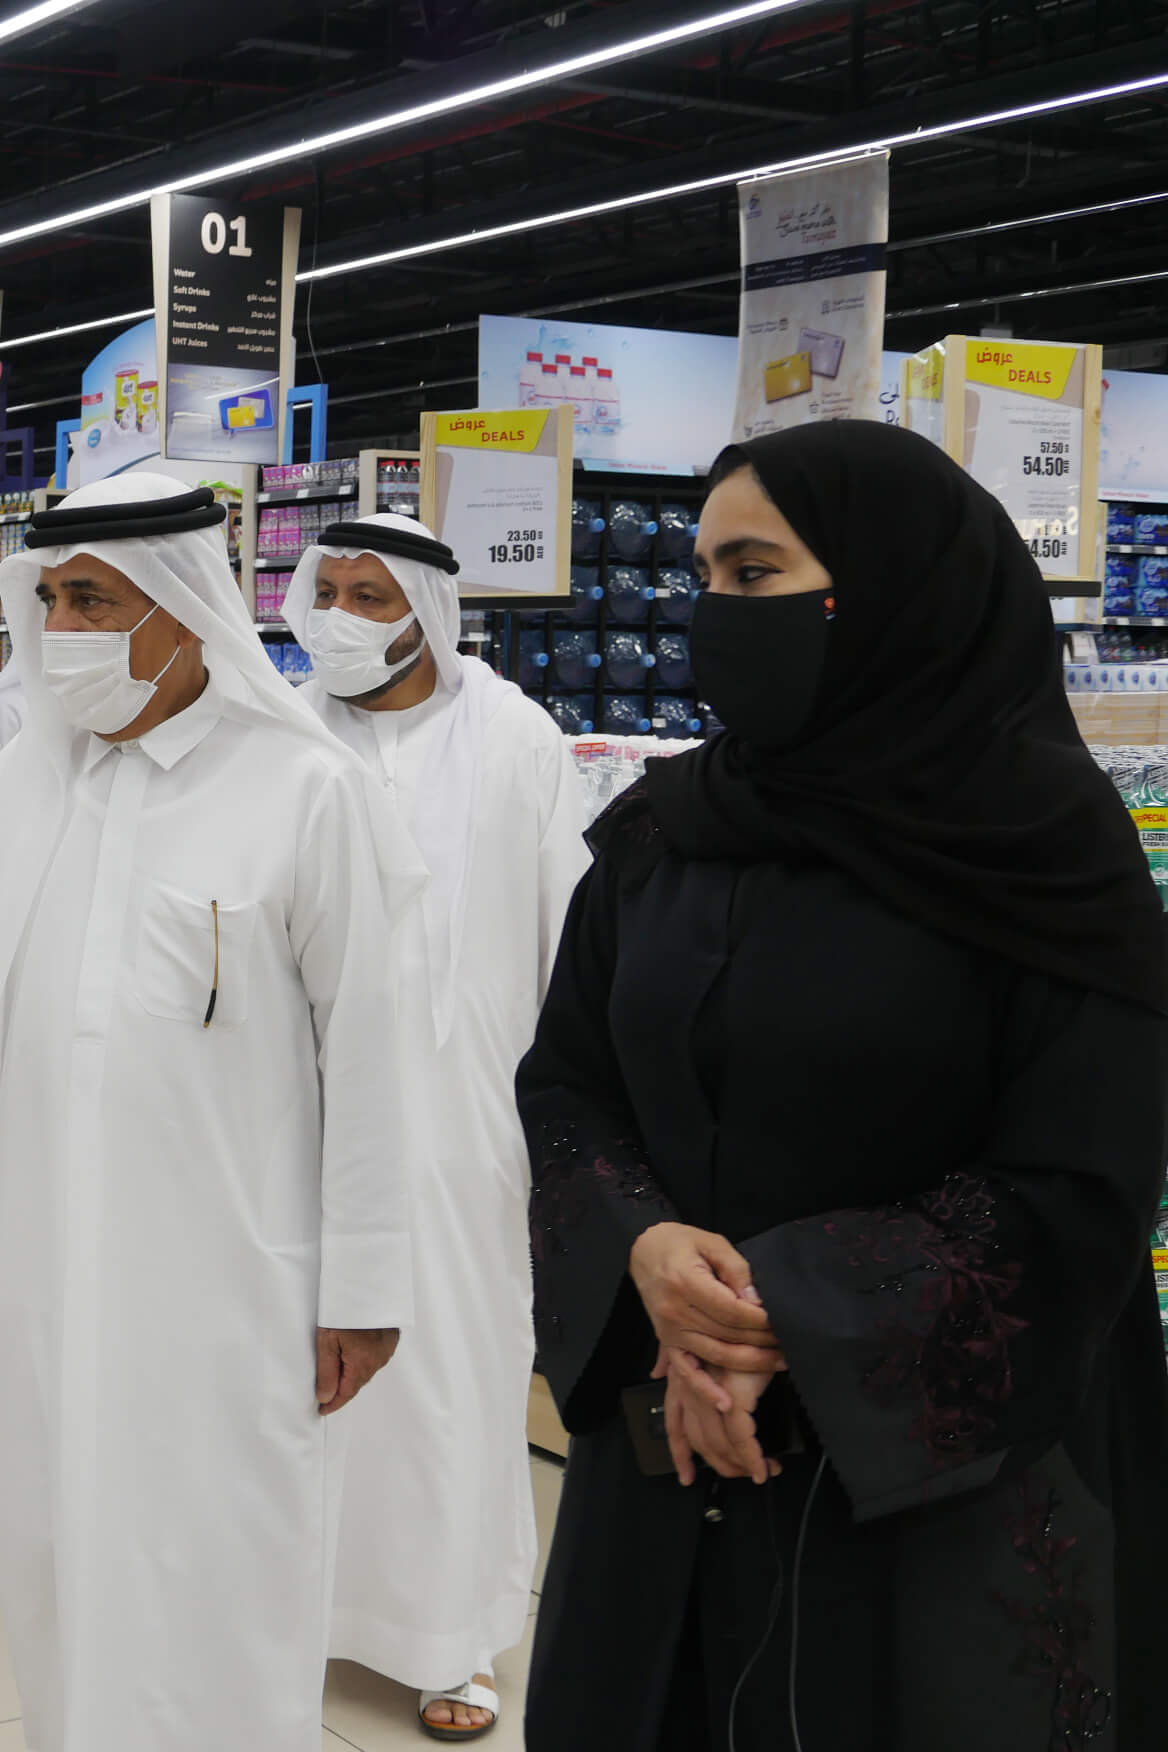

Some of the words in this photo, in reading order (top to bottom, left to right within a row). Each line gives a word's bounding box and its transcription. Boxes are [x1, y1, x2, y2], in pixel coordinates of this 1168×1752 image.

[200, 212, 252, 257] 01
[173, 268, 196, 278] Water
[173, 286, 187, 295] Soft
[188, 287, 210, 297] Drinks
[173, 302, 197, 314] Syrups
[172, 320, 197, 330] Instant
[197, 321, 220, 332] Drinks
[172, 337, 187, 346] UHT
[188, 338, 208, 348] Juices
[977, 347, 1013, 365] عروض
[1008, 369, 1052, 384] DEALS
[449, 418, 486, 431] عروض
[481, 430, 525, 442] DEALS
[1040, 441, 1063, 454] 57.50
[1023, 455, 1063, 476] 54.50
[507, 530, 537, 542] 23.50
[488, 544, 535, 563] 19.50
